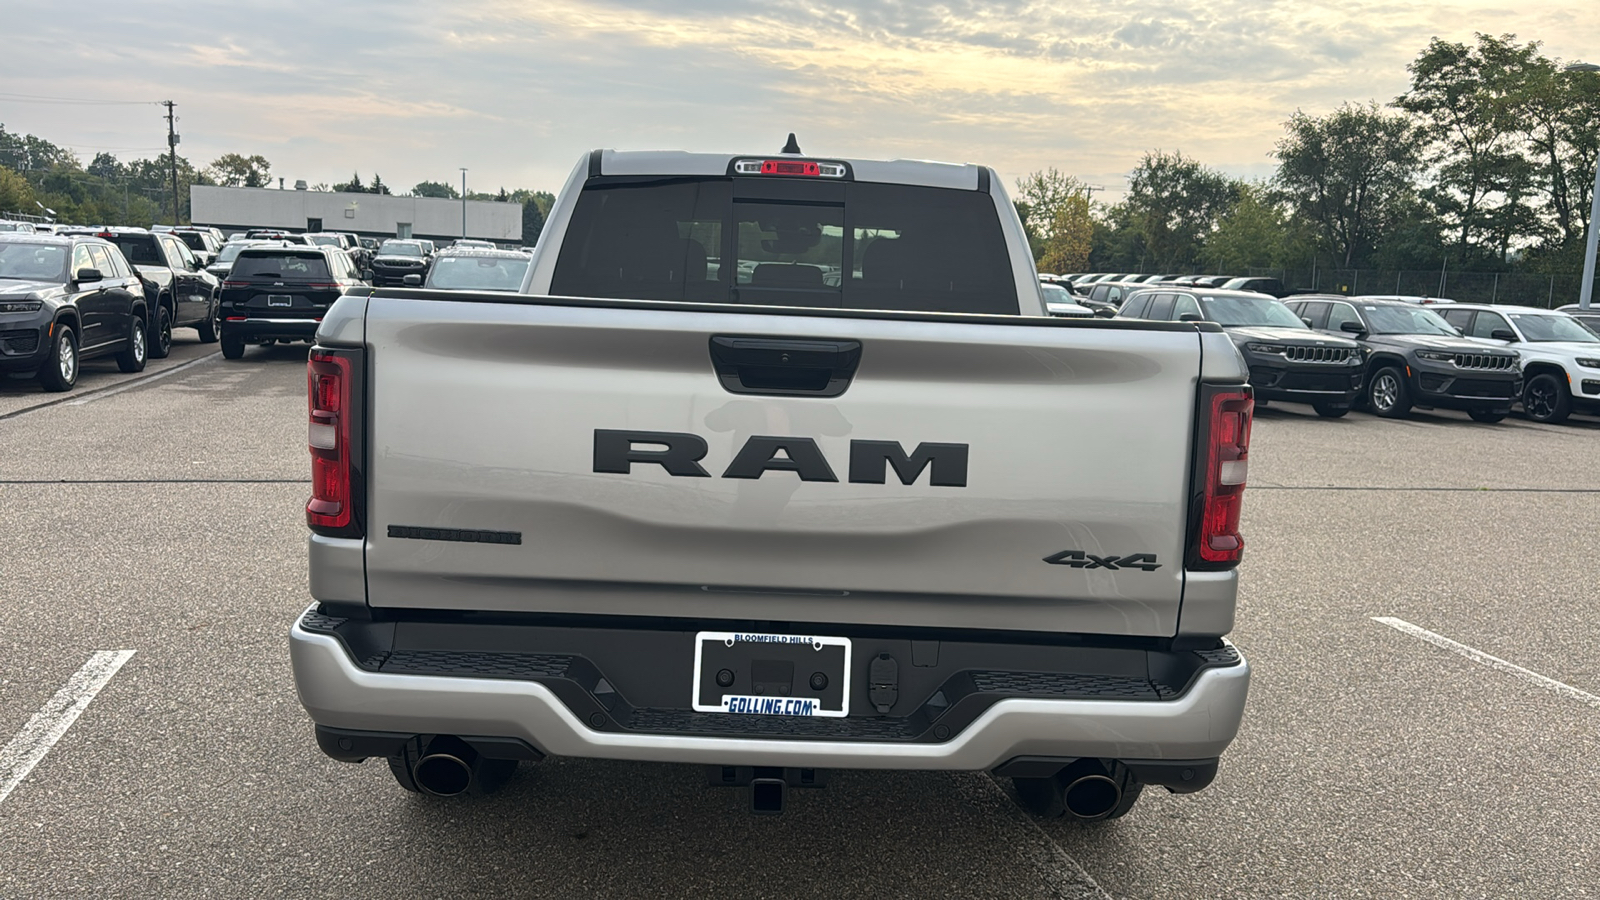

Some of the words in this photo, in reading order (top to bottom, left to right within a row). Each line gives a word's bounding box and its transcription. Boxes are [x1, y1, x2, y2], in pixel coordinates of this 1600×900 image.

[593, 428, 969, 487] RAM
[1042, 550, 1162, 571] 4x4
[734, 633, 788, 643] BLOOMFIELD
[789, 636, 814, 645] HILLS
[728, 697, 813, 716] GOLLING.COM
